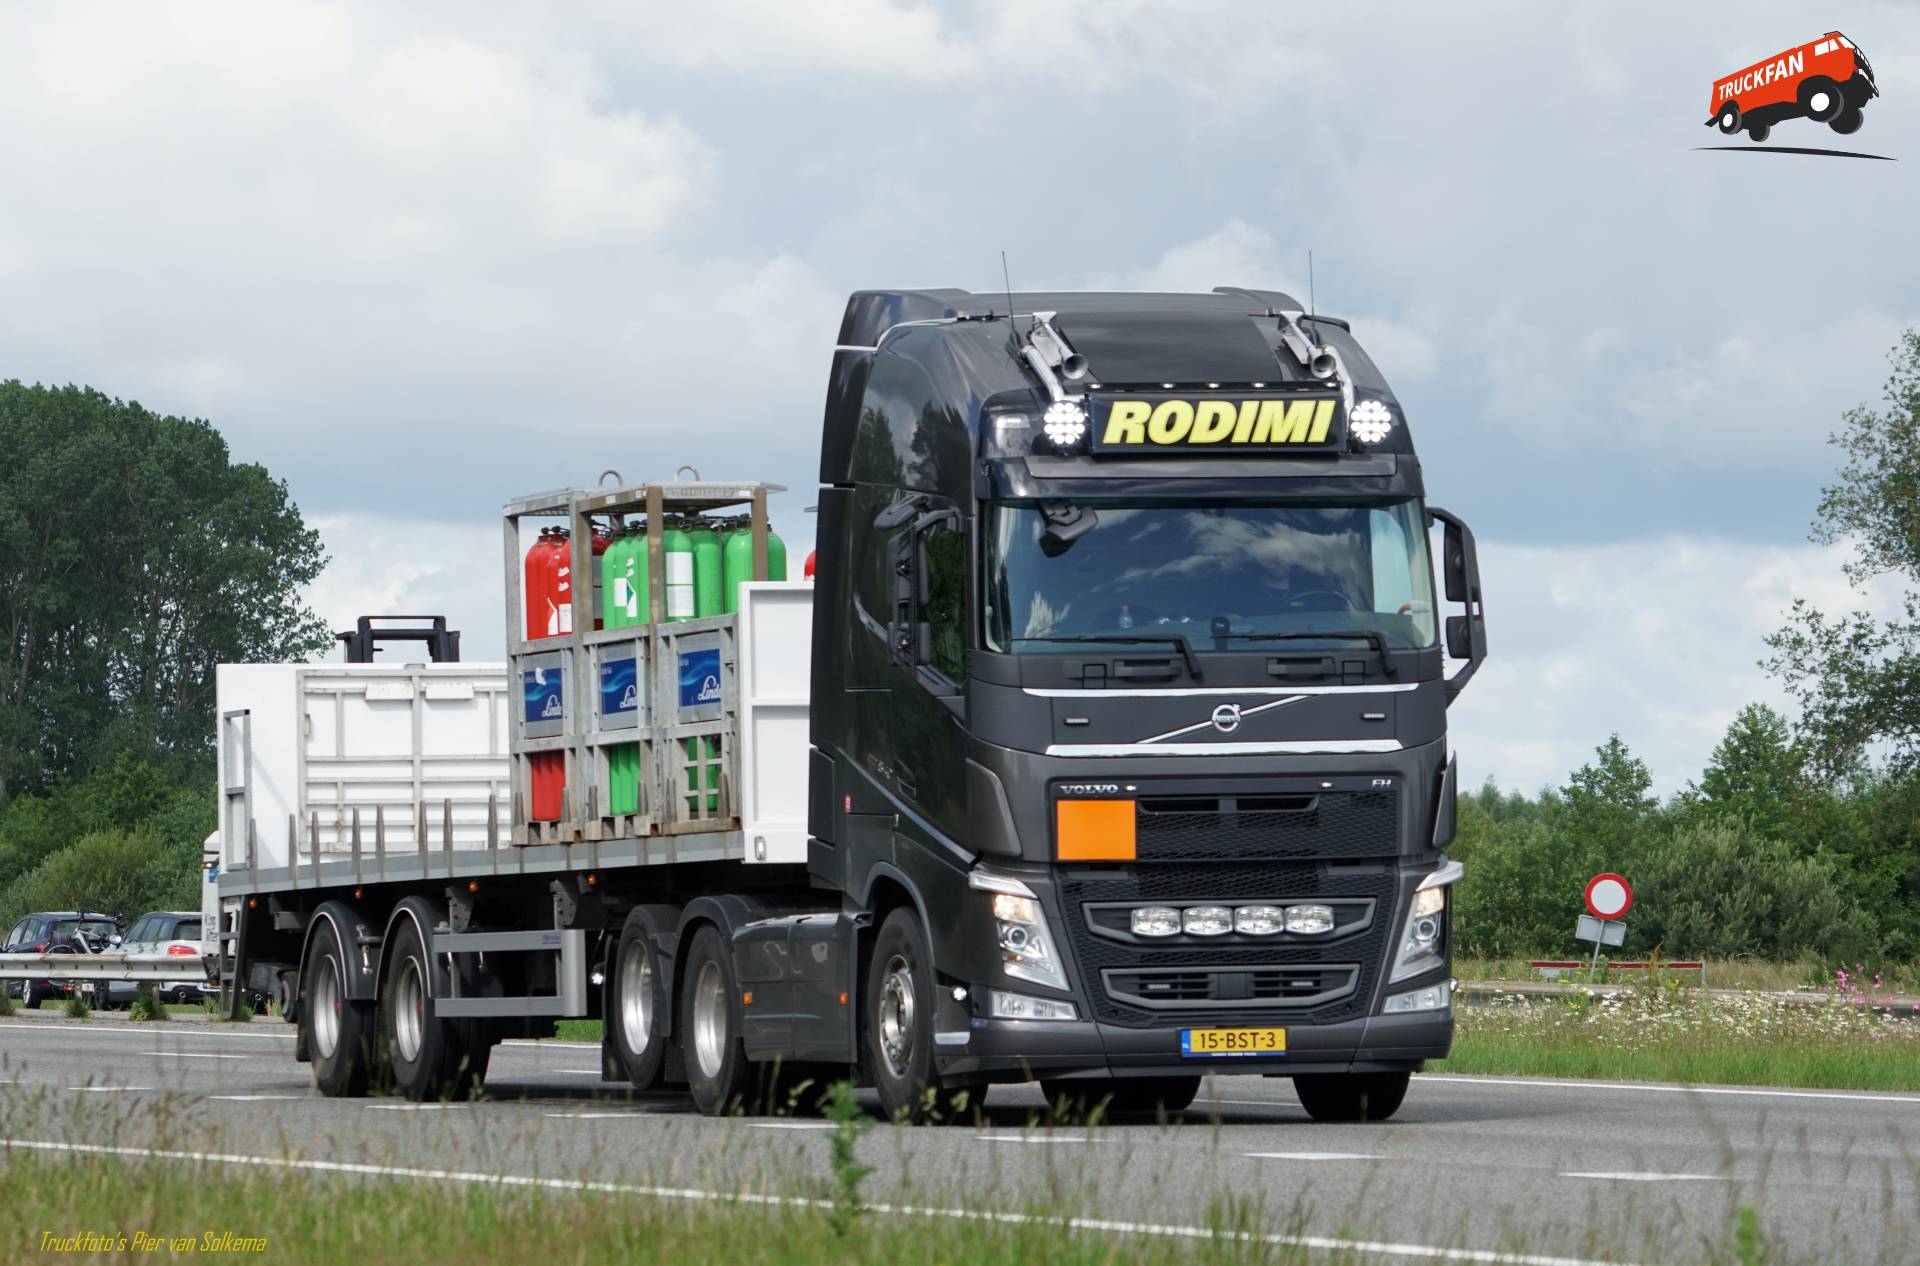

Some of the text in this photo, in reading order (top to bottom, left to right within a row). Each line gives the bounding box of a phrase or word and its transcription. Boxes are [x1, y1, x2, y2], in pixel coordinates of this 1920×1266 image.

[1103, 400, 1337, 445] RODIMI
[1059, 784, 1119, 794] VOLVO
[1372, 779, 1392, 788] FH
[1200, 1032, 1276, 1048] 15-BST-3
